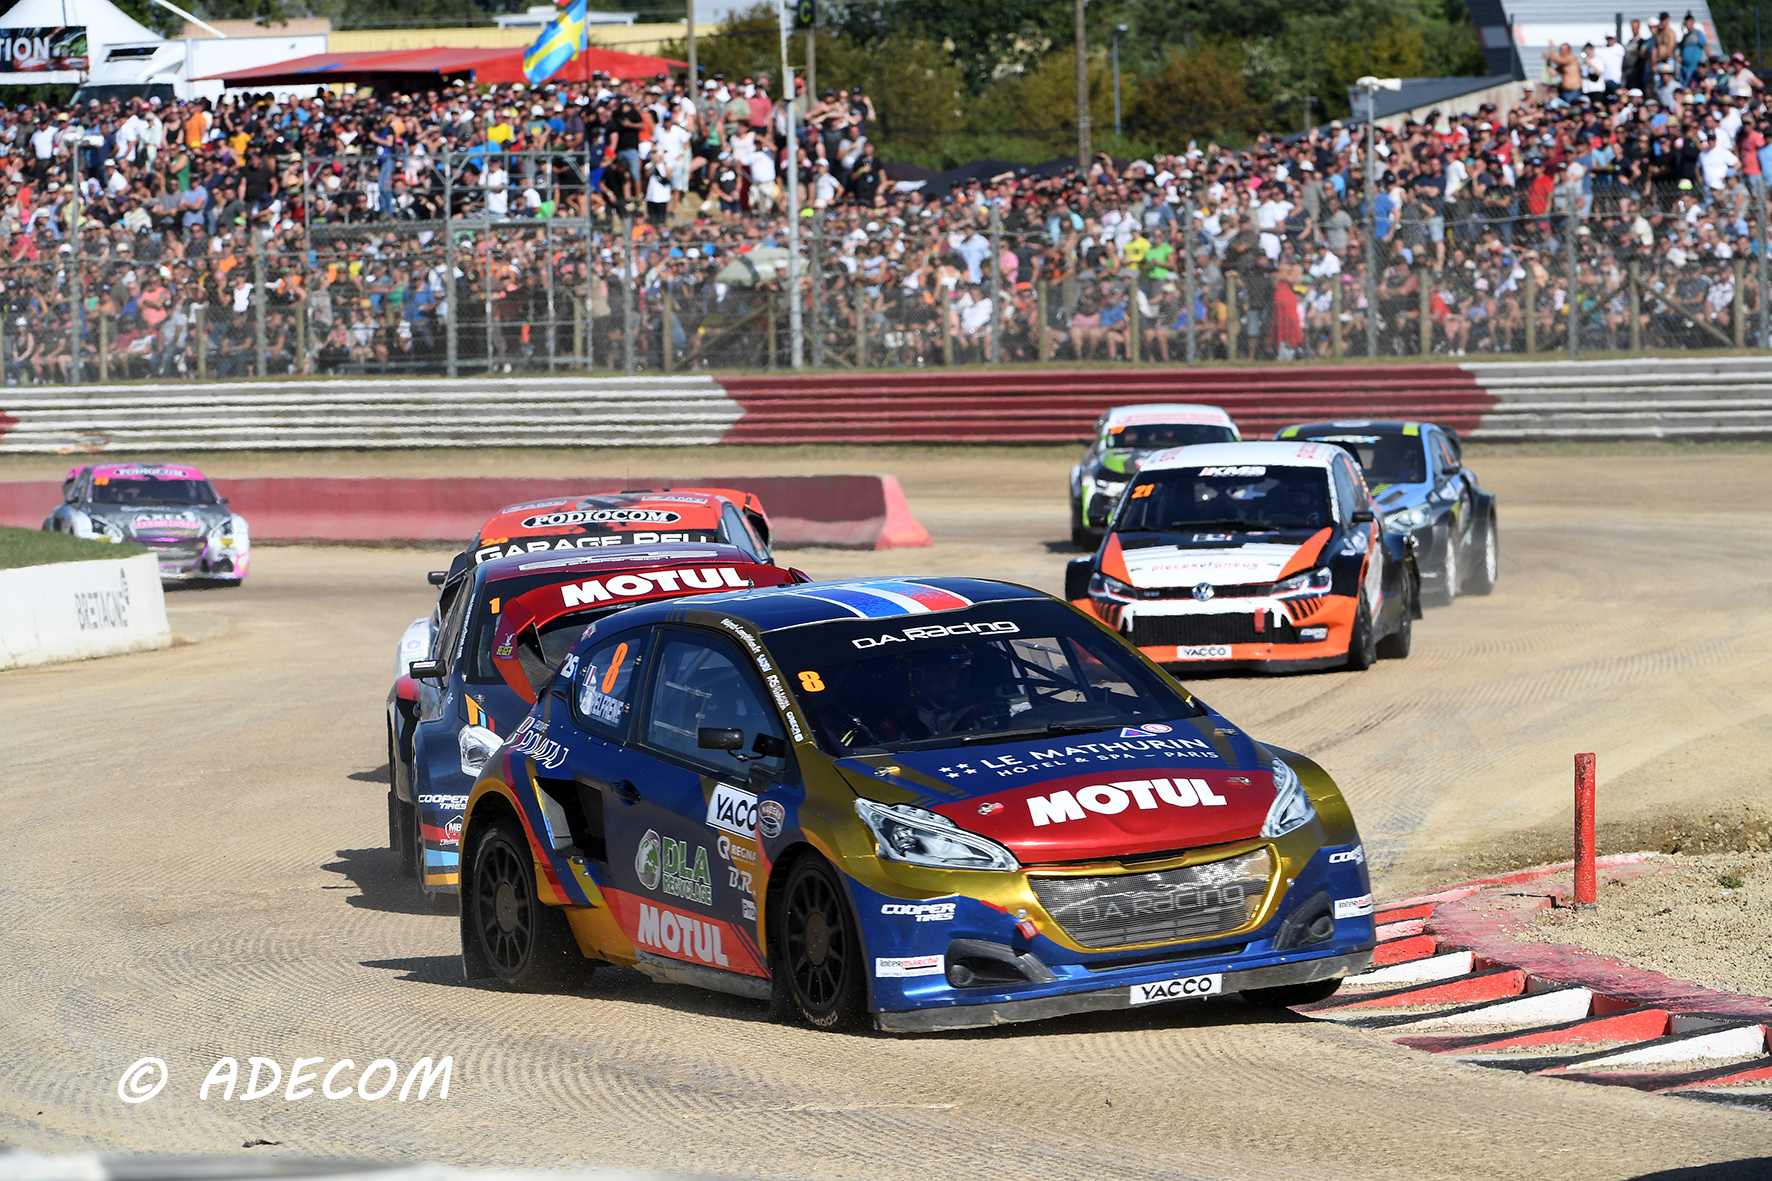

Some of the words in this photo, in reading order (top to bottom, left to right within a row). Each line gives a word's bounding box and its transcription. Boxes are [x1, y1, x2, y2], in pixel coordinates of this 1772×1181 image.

[1131, 483, 1155, 499] 21
[533, 508, 669, 527] PODIOCOM
[561, 567, 752, 607] MOTUL
[74, 591, 128, 631] BRETAGNE
[489, 597, 501, 614] 1
[1183, 648, 1227, 656] YACCO
[601, 642, 629, 694] 8
[797, 670, 826, 693] 8
[981, 754, 1023, 769] LE
[1029, 738, 1209, 761] MATHURIN
[1099, 753, 1135, 761] SPA
[1164, 751, 1219, 759] PARIS
[418, 794, 470, 803] COOPER
[1027, 778, 1227, 827] MOTUL
[663, 836, 711, 885] DLA
[662, 873, 712, 906] RECYCLAGE
[880, 903, 956, 915] COOPER
[914, 914, 955, 922] TIRES
[638, 903, 729, 967] MOTUL
[1142, 977, 1212, 999] YACCO
